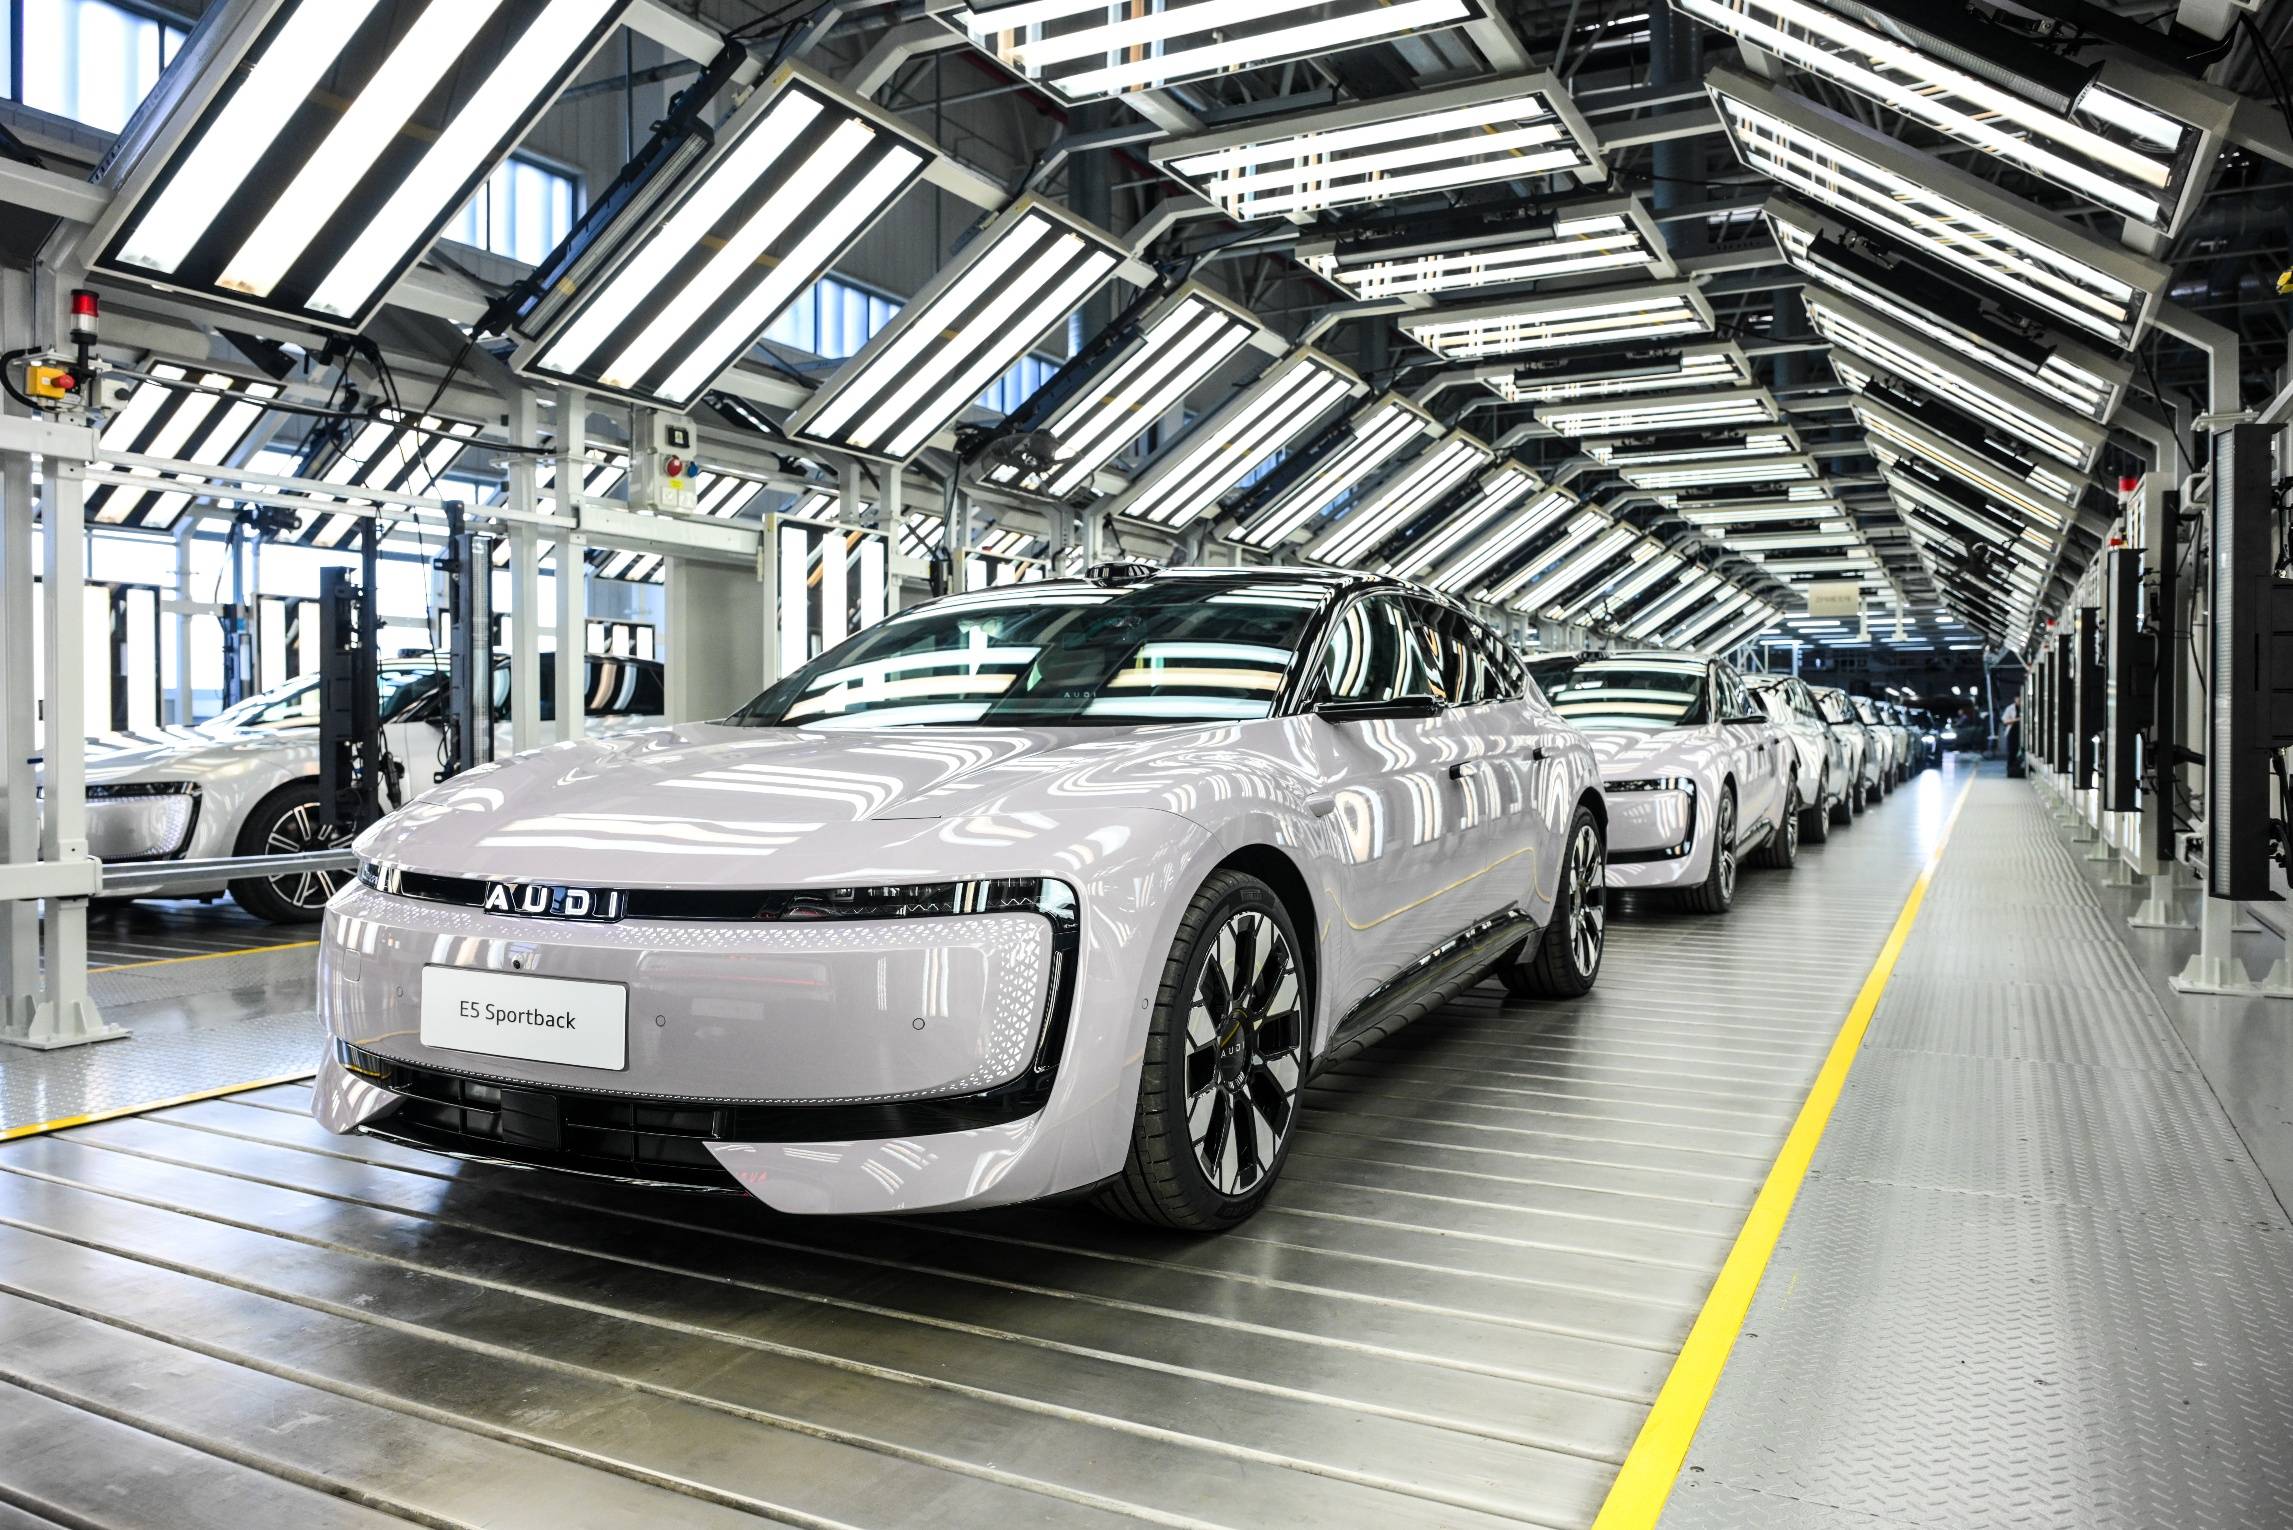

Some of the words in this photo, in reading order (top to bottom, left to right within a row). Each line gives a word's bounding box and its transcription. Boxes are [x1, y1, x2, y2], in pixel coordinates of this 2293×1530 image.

[485, 884, 618, 918] AUDI
[460, 1000, 480, 1018] E5
[485, 1003, 576, 1030] Sportback
